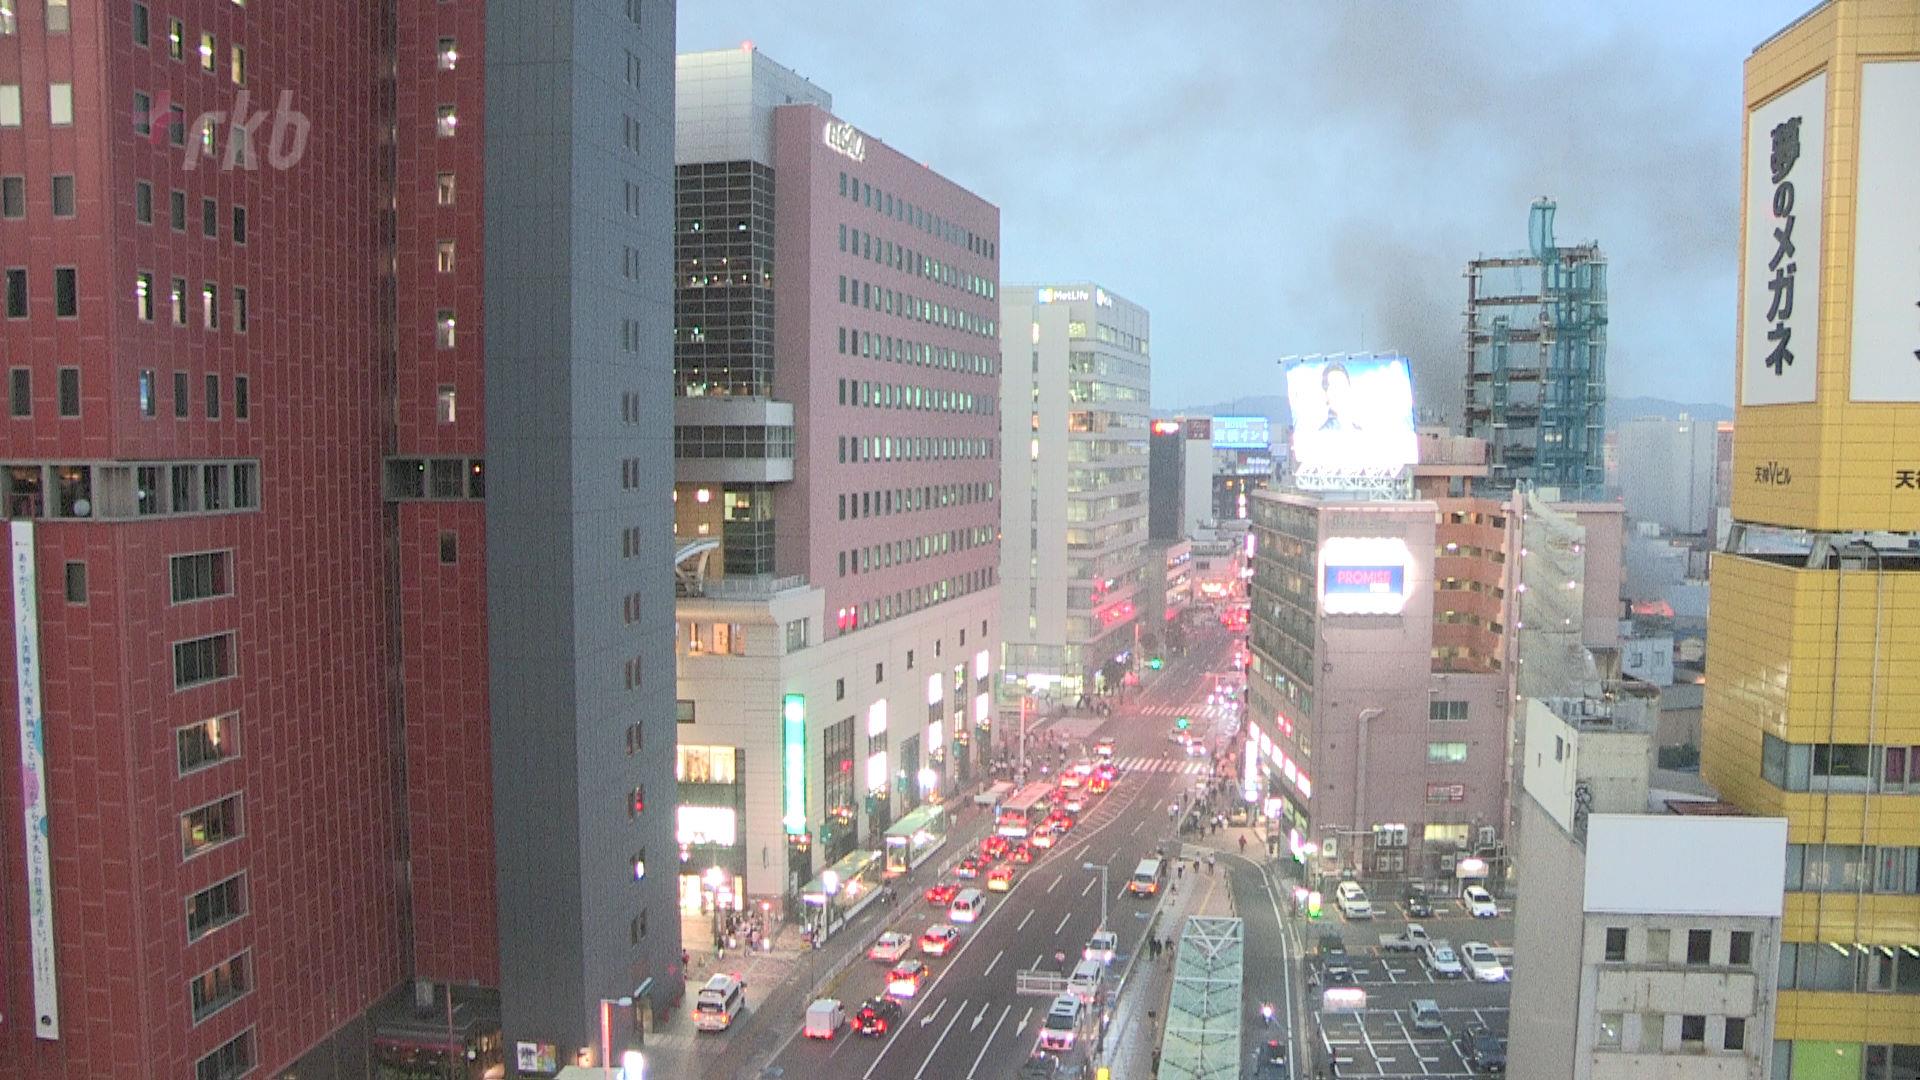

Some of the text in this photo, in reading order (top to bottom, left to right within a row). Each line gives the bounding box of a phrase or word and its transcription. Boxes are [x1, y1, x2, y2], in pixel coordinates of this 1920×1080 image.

[1765, 116, 1802, 375] 夢のメガネ
[1337, 571, 1390, 585] PROMISE
